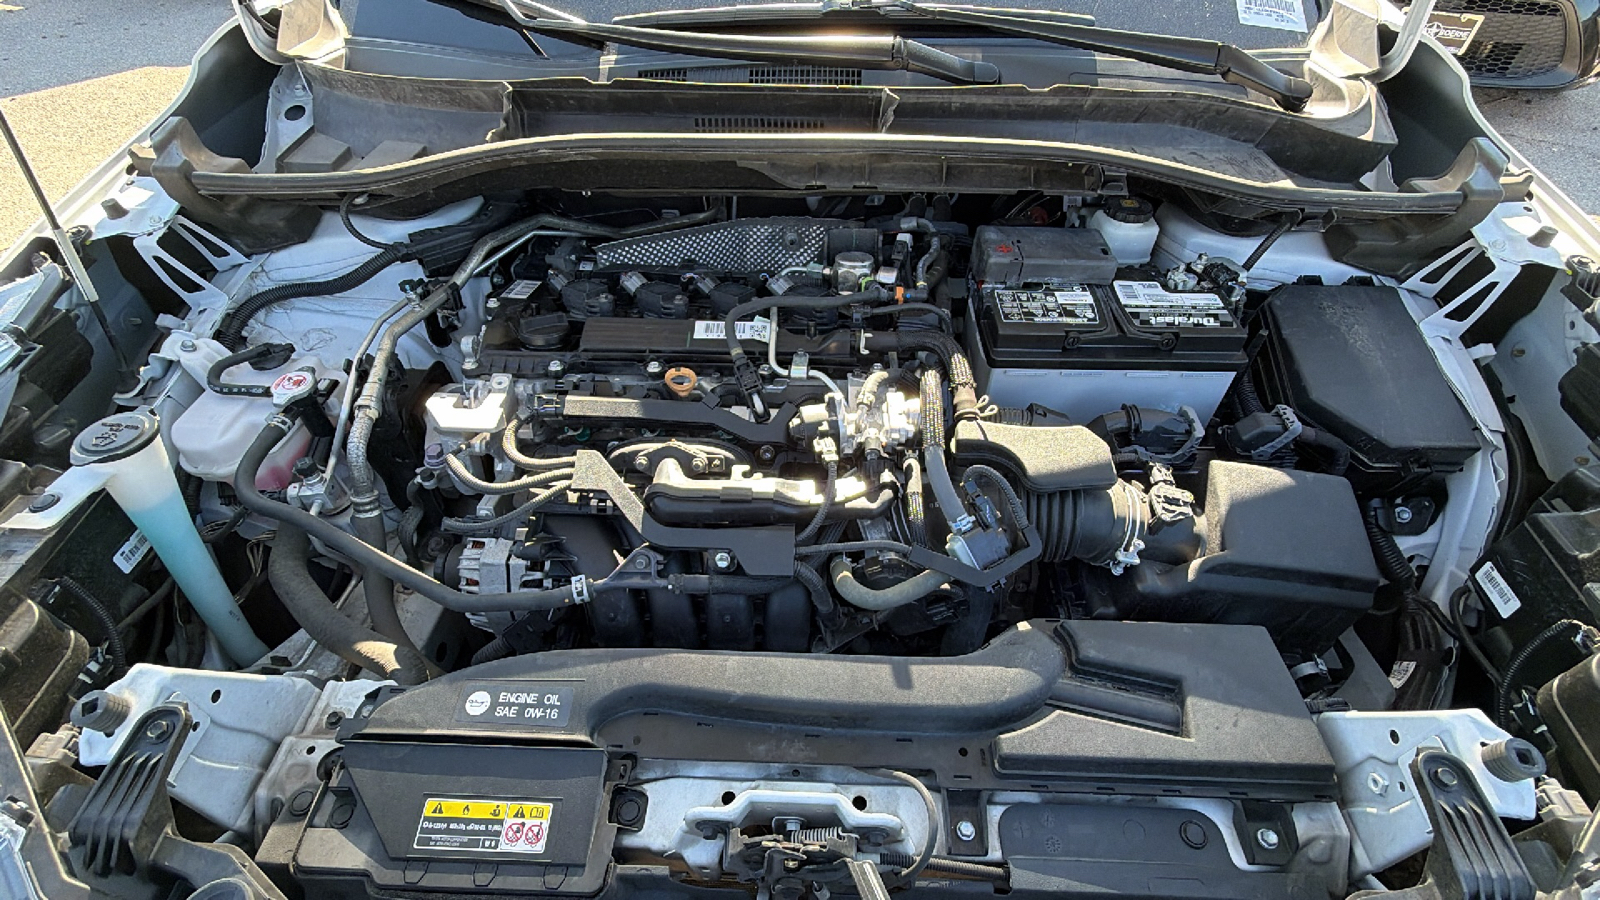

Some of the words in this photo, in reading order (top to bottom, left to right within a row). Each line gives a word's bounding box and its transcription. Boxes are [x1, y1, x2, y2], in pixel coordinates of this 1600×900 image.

[1149, 316, 1220, 326] Duralast
[498, 692, 538, 704] ENGINE
[544, 694, 560, 705] OIL
[494, 706, 518, 717] SAE
[524, 708, 559, 719] 0W-16
